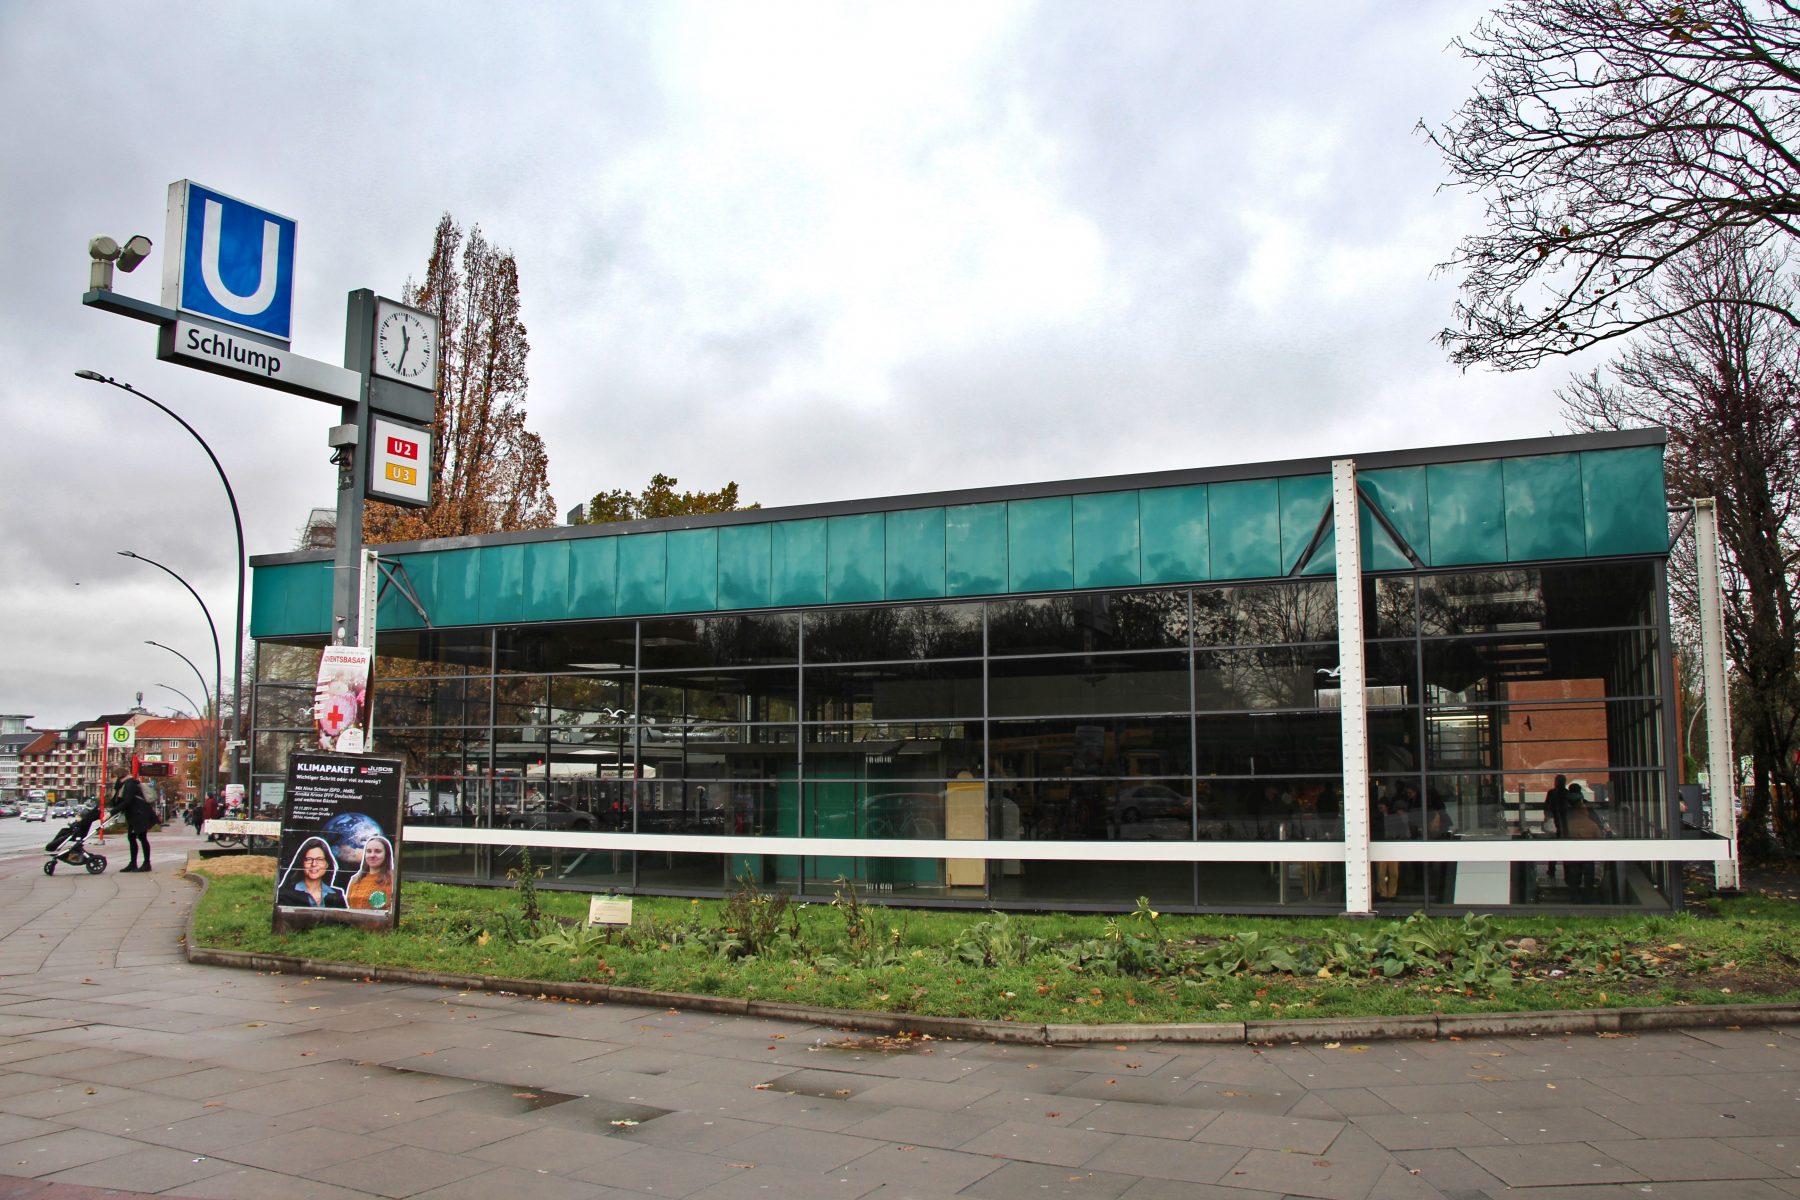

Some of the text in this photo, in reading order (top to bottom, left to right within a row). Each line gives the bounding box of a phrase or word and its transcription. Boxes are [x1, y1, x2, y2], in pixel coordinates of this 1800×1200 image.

[201, 198, 280, 315] U
[187, 328, 281, 375] Schlump
[394, 440, 411, 456] U2
[393, 466, 410, 481] U3
[297, 763, 355, 774] KLIMAPAKET
